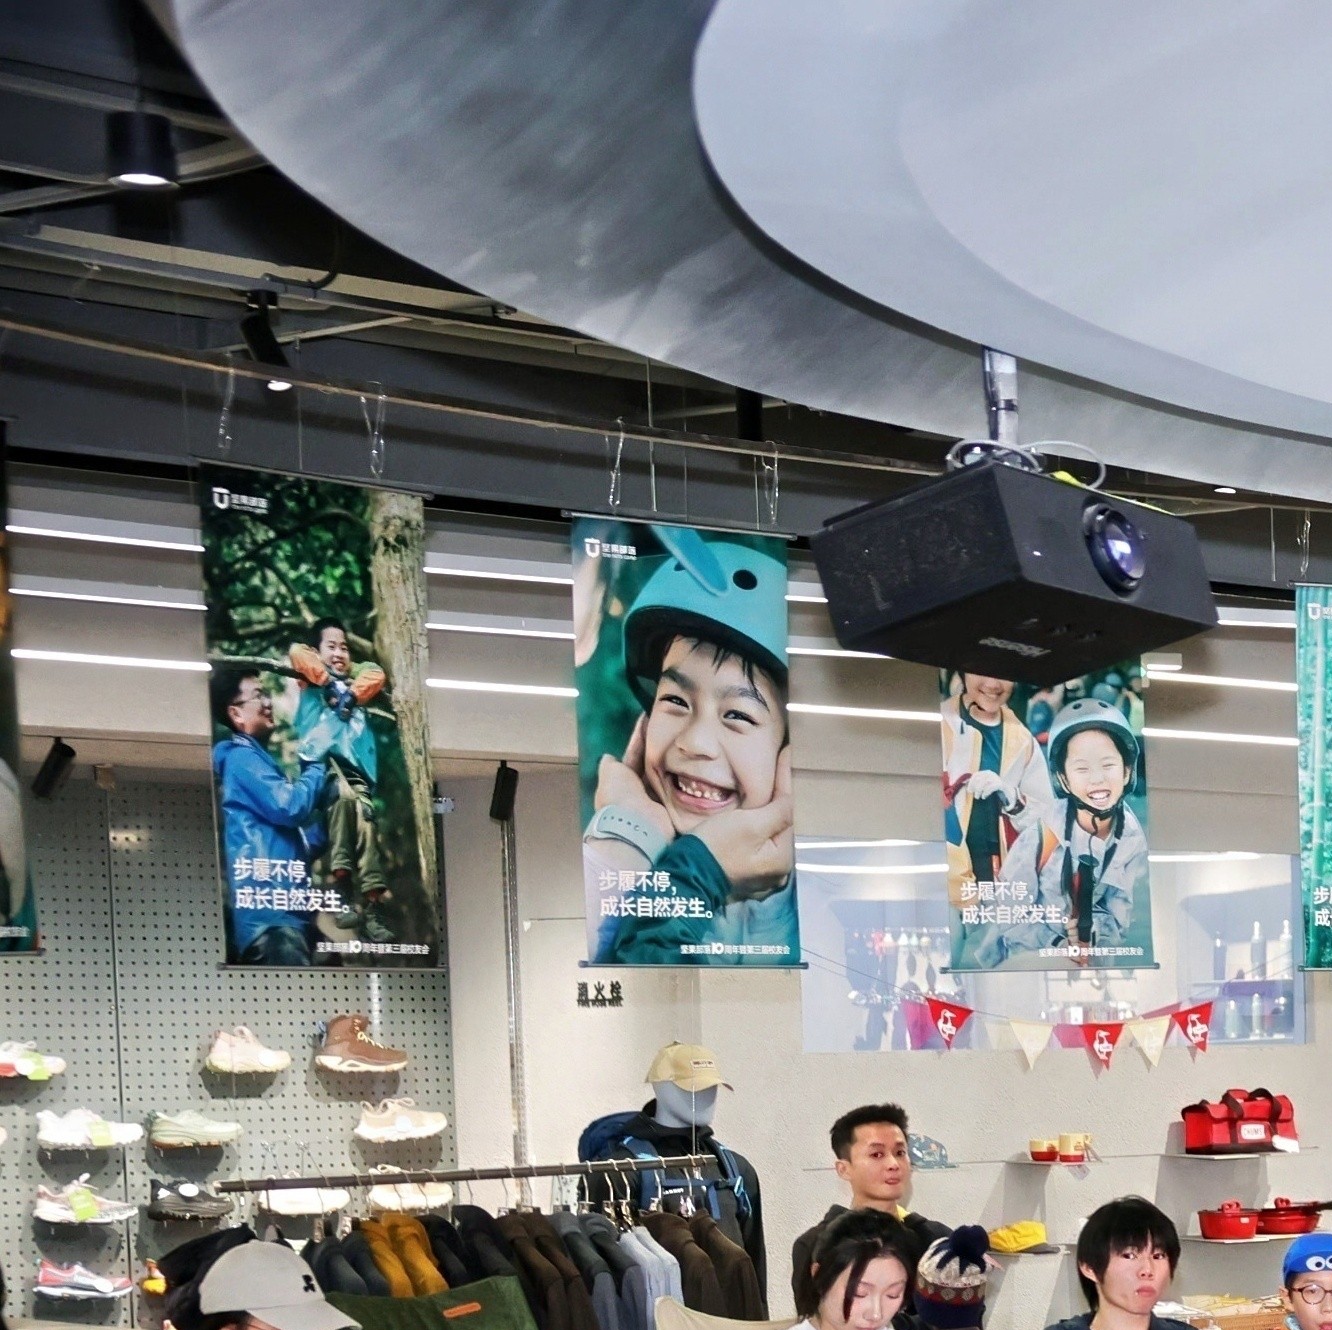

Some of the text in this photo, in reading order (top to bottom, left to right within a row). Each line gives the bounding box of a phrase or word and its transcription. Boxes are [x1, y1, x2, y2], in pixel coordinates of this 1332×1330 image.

[236, 886, 349, 913] 成长自然发生。
[601, 897, 713, 918] 成长自然发生。
[962, 904, 1069, 924] 成长自然发生。
